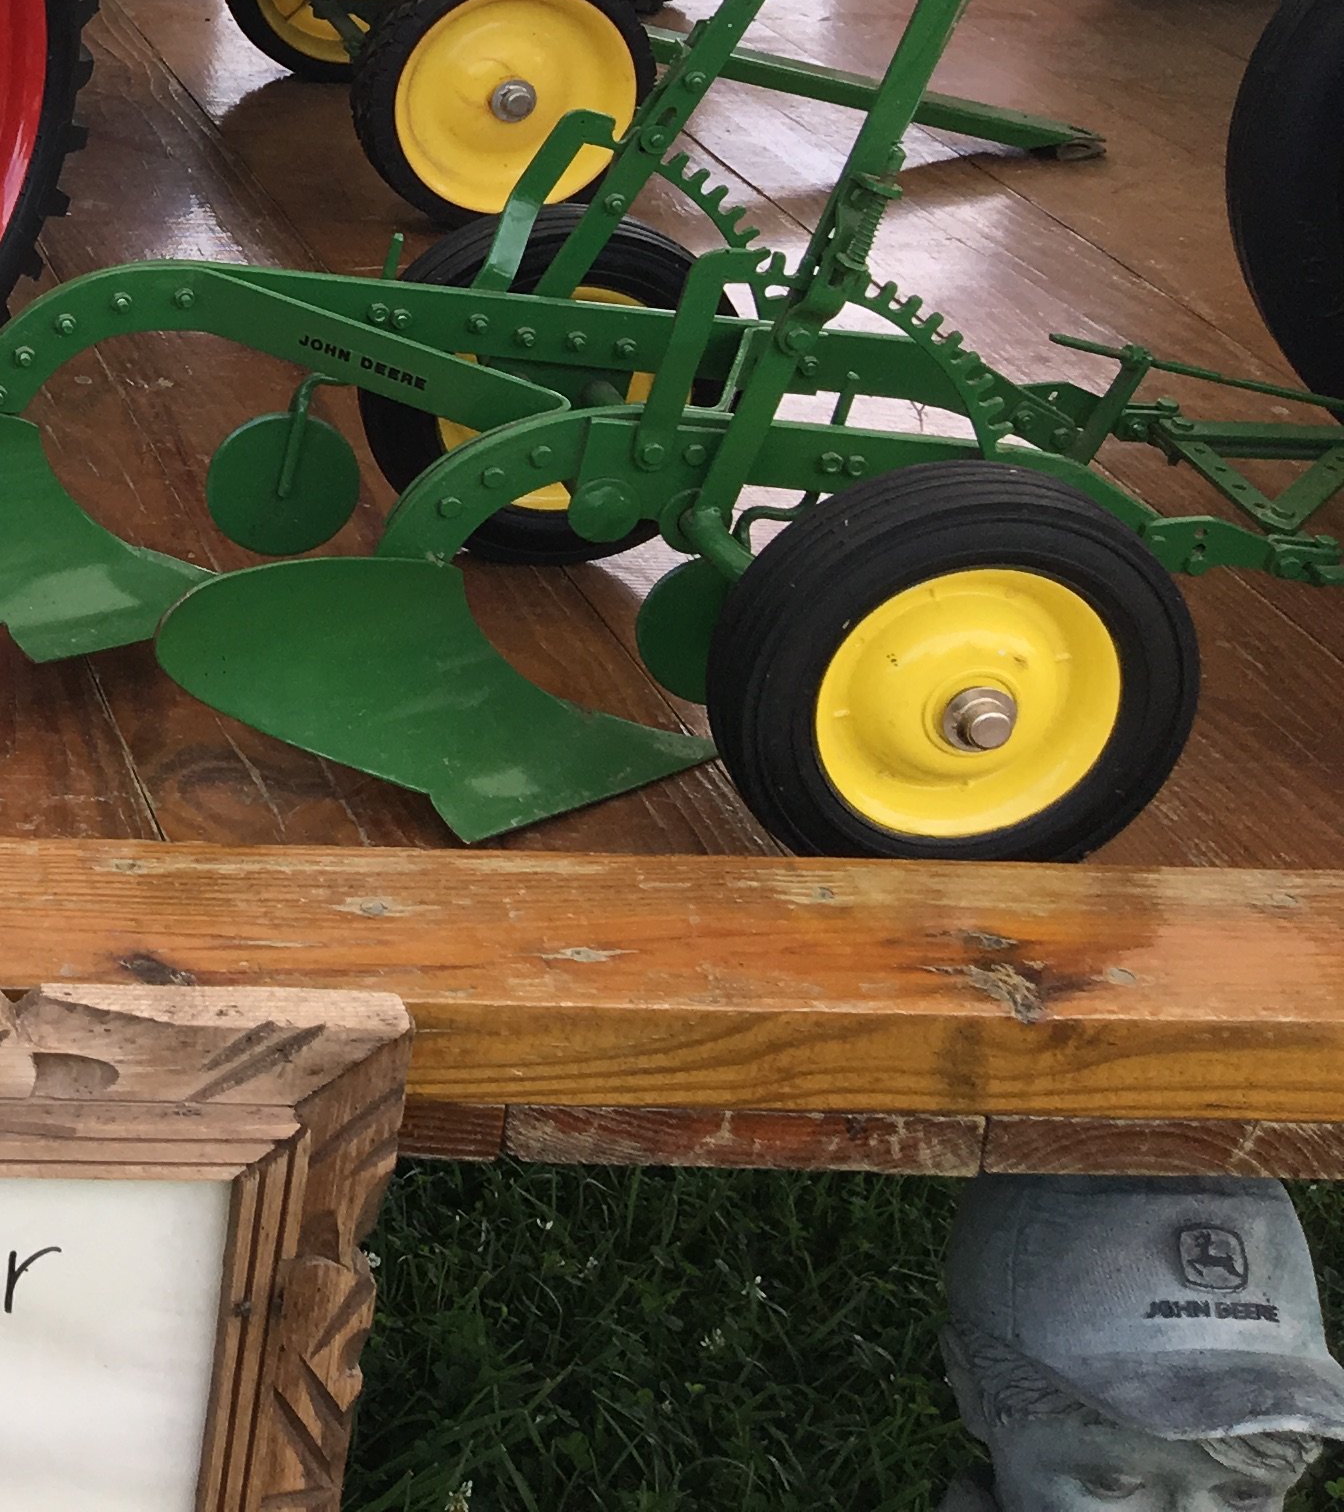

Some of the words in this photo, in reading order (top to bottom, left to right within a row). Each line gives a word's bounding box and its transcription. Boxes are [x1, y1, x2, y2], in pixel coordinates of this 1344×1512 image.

[298, 335, 352, 363] JOHN
[360, 356, 427, 391] DEERE
[1143, 1300, 1212, 1319] JOHN
[1214, 1301, 1281, 1324] DEERE
